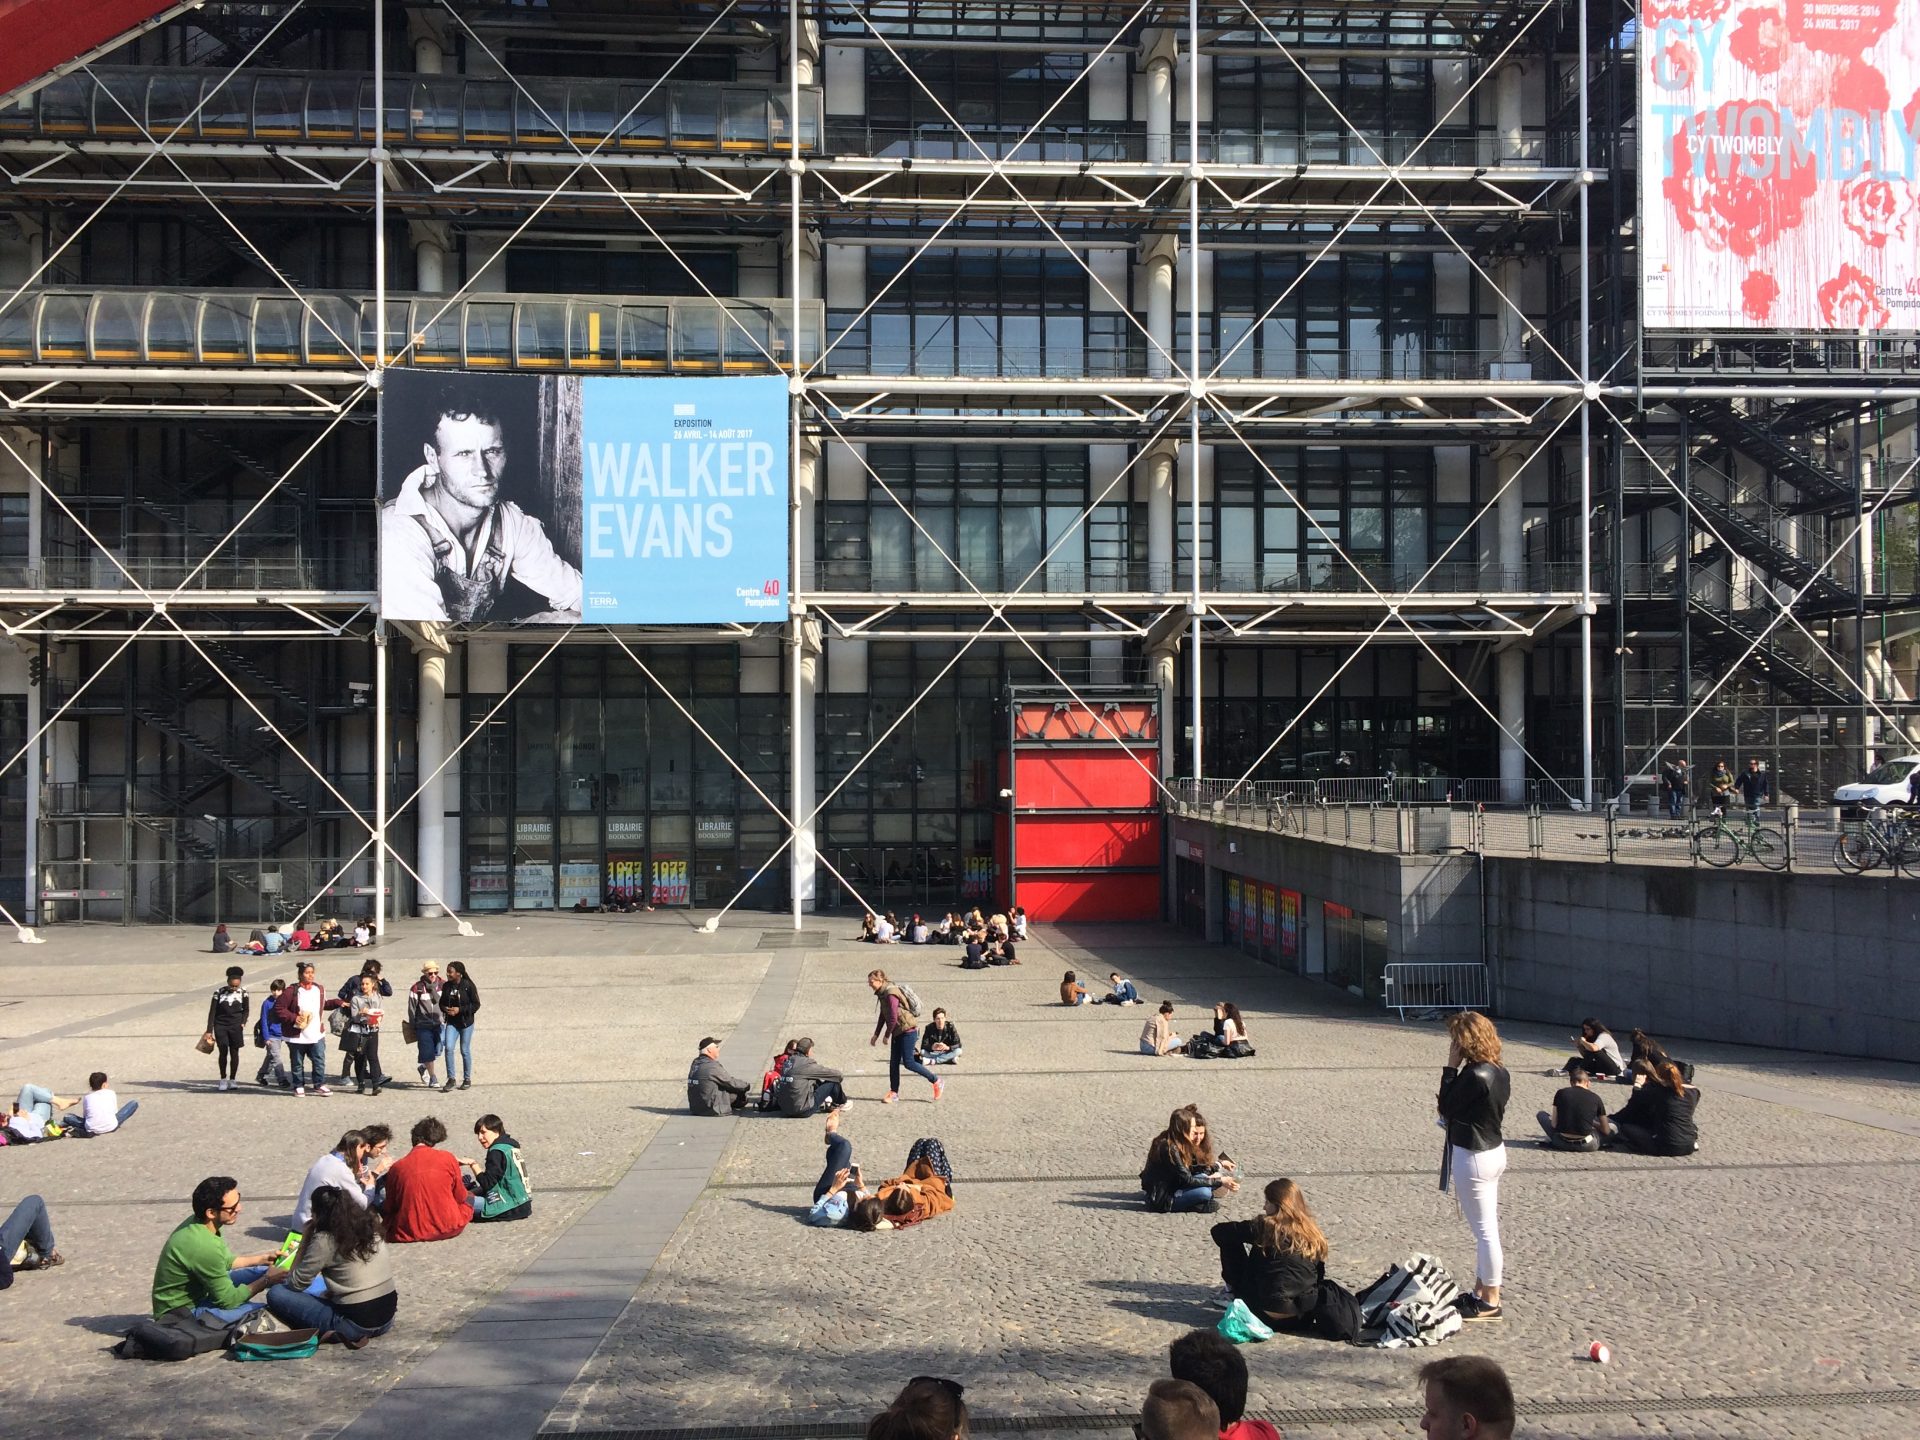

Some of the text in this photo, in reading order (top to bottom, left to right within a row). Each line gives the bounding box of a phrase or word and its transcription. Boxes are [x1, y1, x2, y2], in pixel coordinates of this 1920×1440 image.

[1803, 3, 1880, 17] 30 NOVEMBRE 2016
[1803, 18, 1860, 30] 24 AVRIL 2017
[1655, 18, 1726, 92] CY
[1651, 104, 1920, 182] TWOMBLY
[1687, 135, 1784, 155] CY TWOMBLY
[1647, 274, 1665, 283] pwc
[1876, 285, 1903, 296] Centre
[1694, 309, 1741, 317] FOUNDATION
[674, 419, 712, 428] EXPOSITION
[674, 430, 682, 440] 26
[683, 430, 702, 439] AVRIL
[737, 429, 753, 439] 2017
[588, 441, 775, 498] WALKER
[590, 502, 734, 559] EVANS
[736, 579, 780, 597] Centre 40
[589, 597, 618, 606] TERRA
[745, 597, 780, 608] Pompidou
[516, 823, 552, 833] LIBRAIRIE
[608, 822, 643, 832] LIBRAIRIE
[698, 822, 733, 831] LIBRAIRIE
